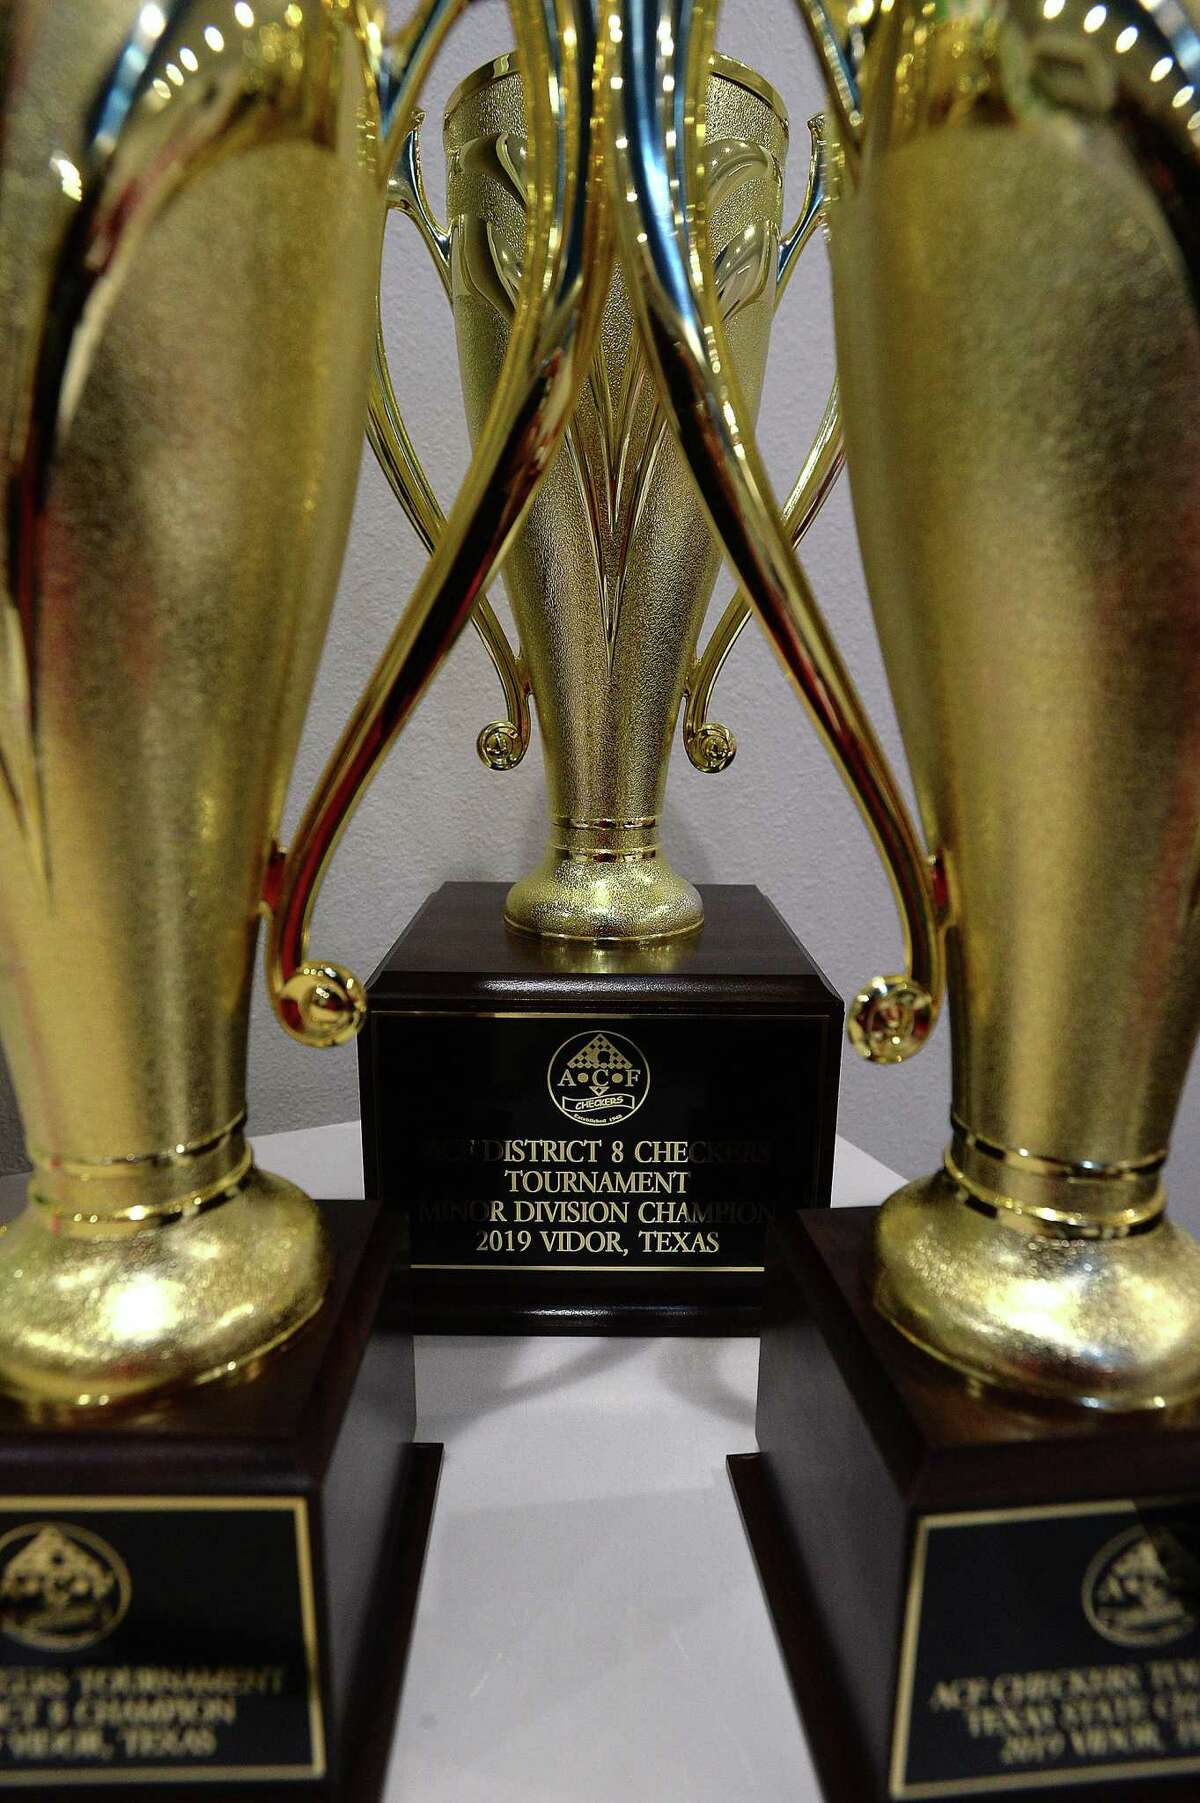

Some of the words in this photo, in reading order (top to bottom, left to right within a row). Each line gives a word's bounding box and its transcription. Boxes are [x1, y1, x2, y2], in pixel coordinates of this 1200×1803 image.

[575, 1096, 624, 1110] CHECKERS
[483, 1139, 602, 1163] DISTRICT
[611, 1140, 624, 1163] 8
[504, 1169, 691, 1194] TOURNAMENT
[418, 1200, 507, 1223] MINOR
[514, 1200, 629, 1224] DIVISION
[637, 1200, 775, 1225] CHAMPION
[475, 1230, 532, 1252] 2019
[541, 1230, 629, 1257] VIDOR,
[638, 1230, 719, 1254] TEXAS
